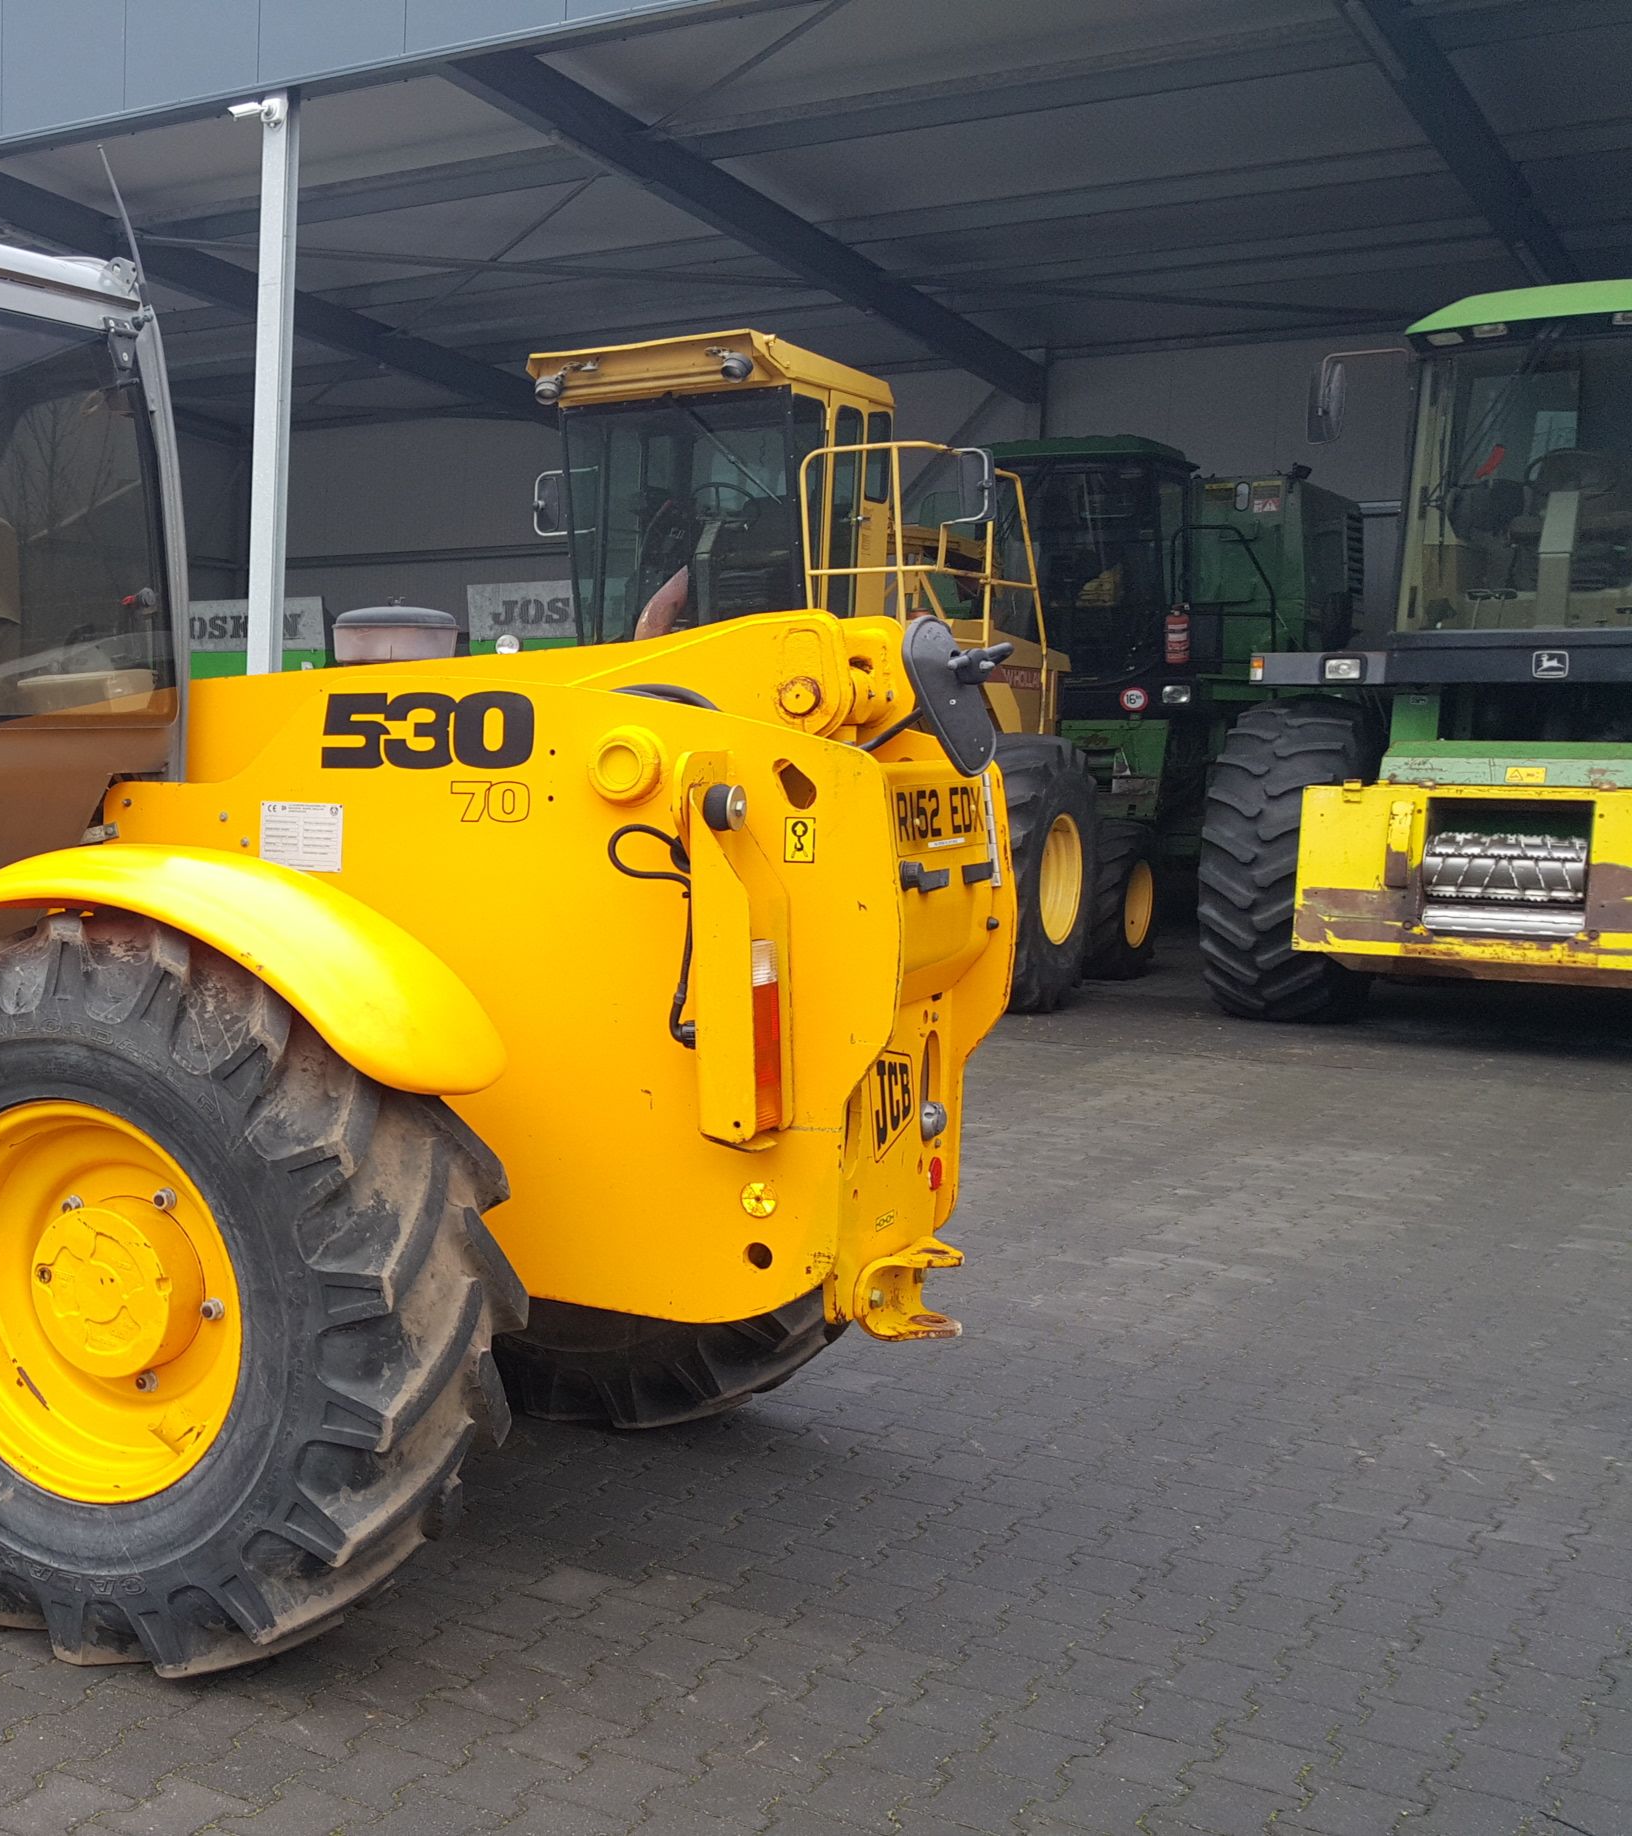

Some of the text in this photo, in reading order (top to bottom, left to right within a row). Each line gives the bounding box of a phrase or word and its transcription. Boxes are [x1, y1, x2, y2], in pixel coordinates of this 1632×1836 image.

[490, 596, 575, 626] JOS
[320, 690, 535, 770] 530
[450, 780, 531, 823] 70
[949, 786, 985, 834] EDX
[875, 1059, 912, 1152] JCB
